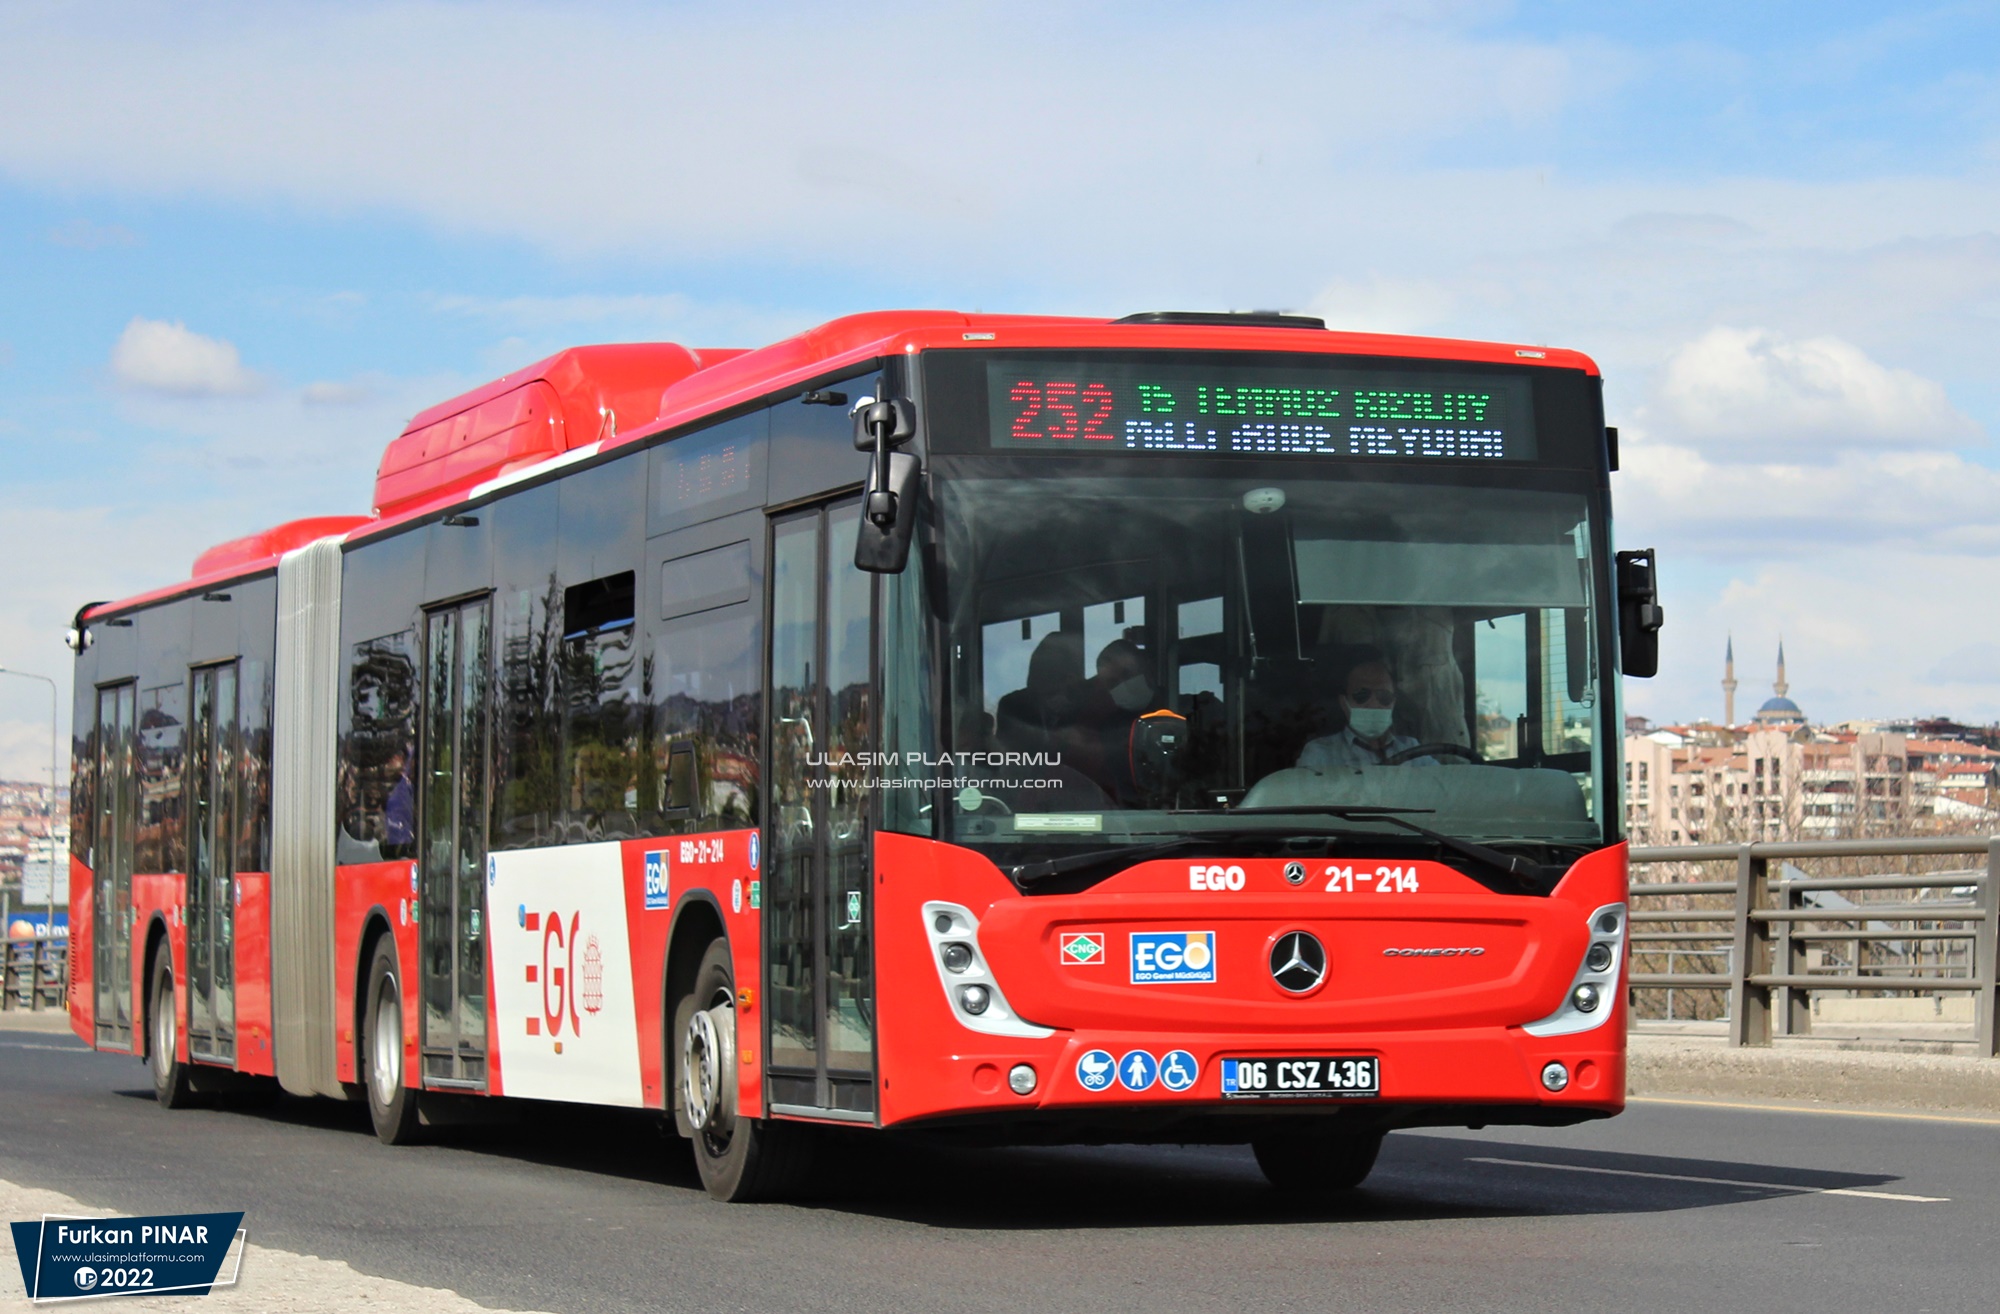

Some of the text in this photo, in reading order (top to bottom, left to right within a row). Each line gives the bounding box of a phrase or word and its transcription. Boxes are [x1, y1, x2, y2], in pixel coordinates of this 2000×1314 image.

[1010, 381, 1115, 439] 252
[646, 862, 669, 895] EGO
[1189, 865, 1246, 891] EGO
[1325, 866, 1419, 893] 21-214
[1069, 943, 1096, 954] CNG
[1135, 941, 1211, 972] EGO
[1382, 947, 1486, 957] CONECTO
[1135, 972, 1152, 980] EGO
[1152, 972, 1175, 980] Genel
[1225, 1078, 1237, 1087] TR
[1238, 1060, 1371, 1090] 06 CSZ 436
